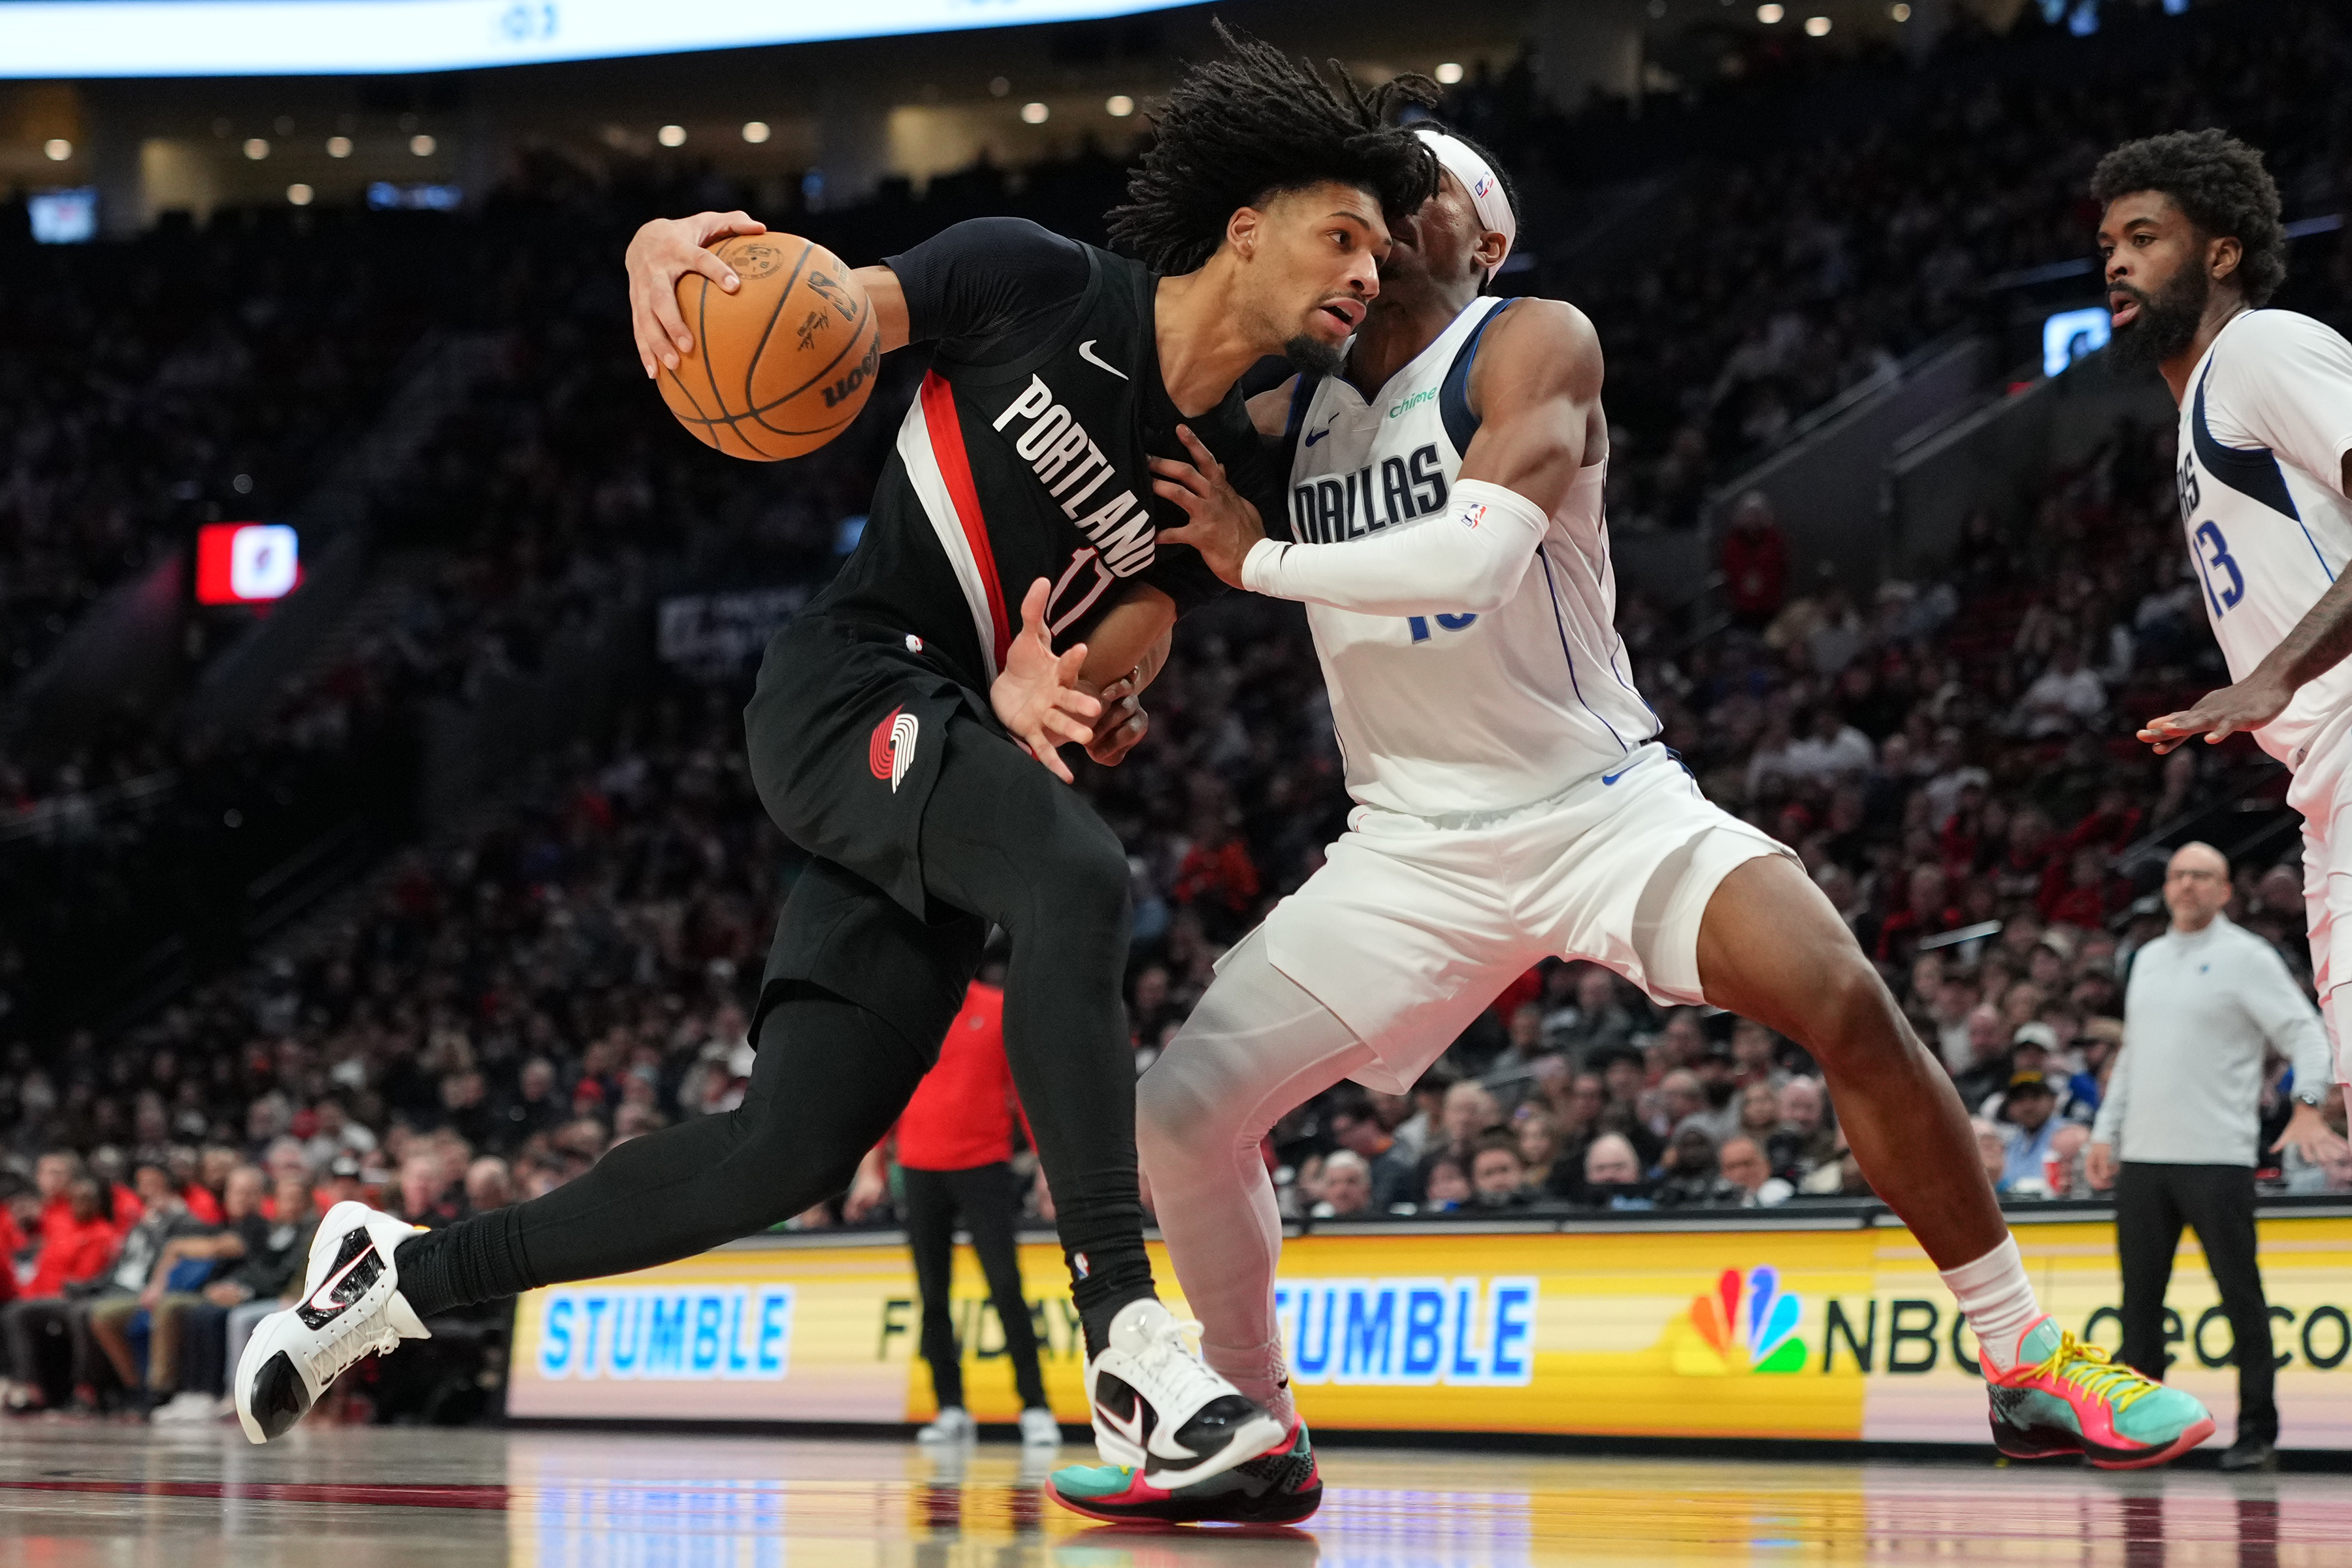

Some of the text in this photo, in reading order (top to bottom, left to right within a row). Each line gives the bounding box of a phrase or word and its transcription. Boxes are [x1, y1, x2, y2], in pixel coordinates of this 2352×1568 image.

[1390, 387, 1437, 419] chime
[992, 373, 1156, 578] PORTLAND
[1294, 442, 1448, 544] DALLAS
[1046, 545, 1115, 638] 17
[2192, 519, 2246, 621] 13
[540, 1290, 791, 1376] STUMBLE
[1275, 1282, 1535, 1381] UMBLE
